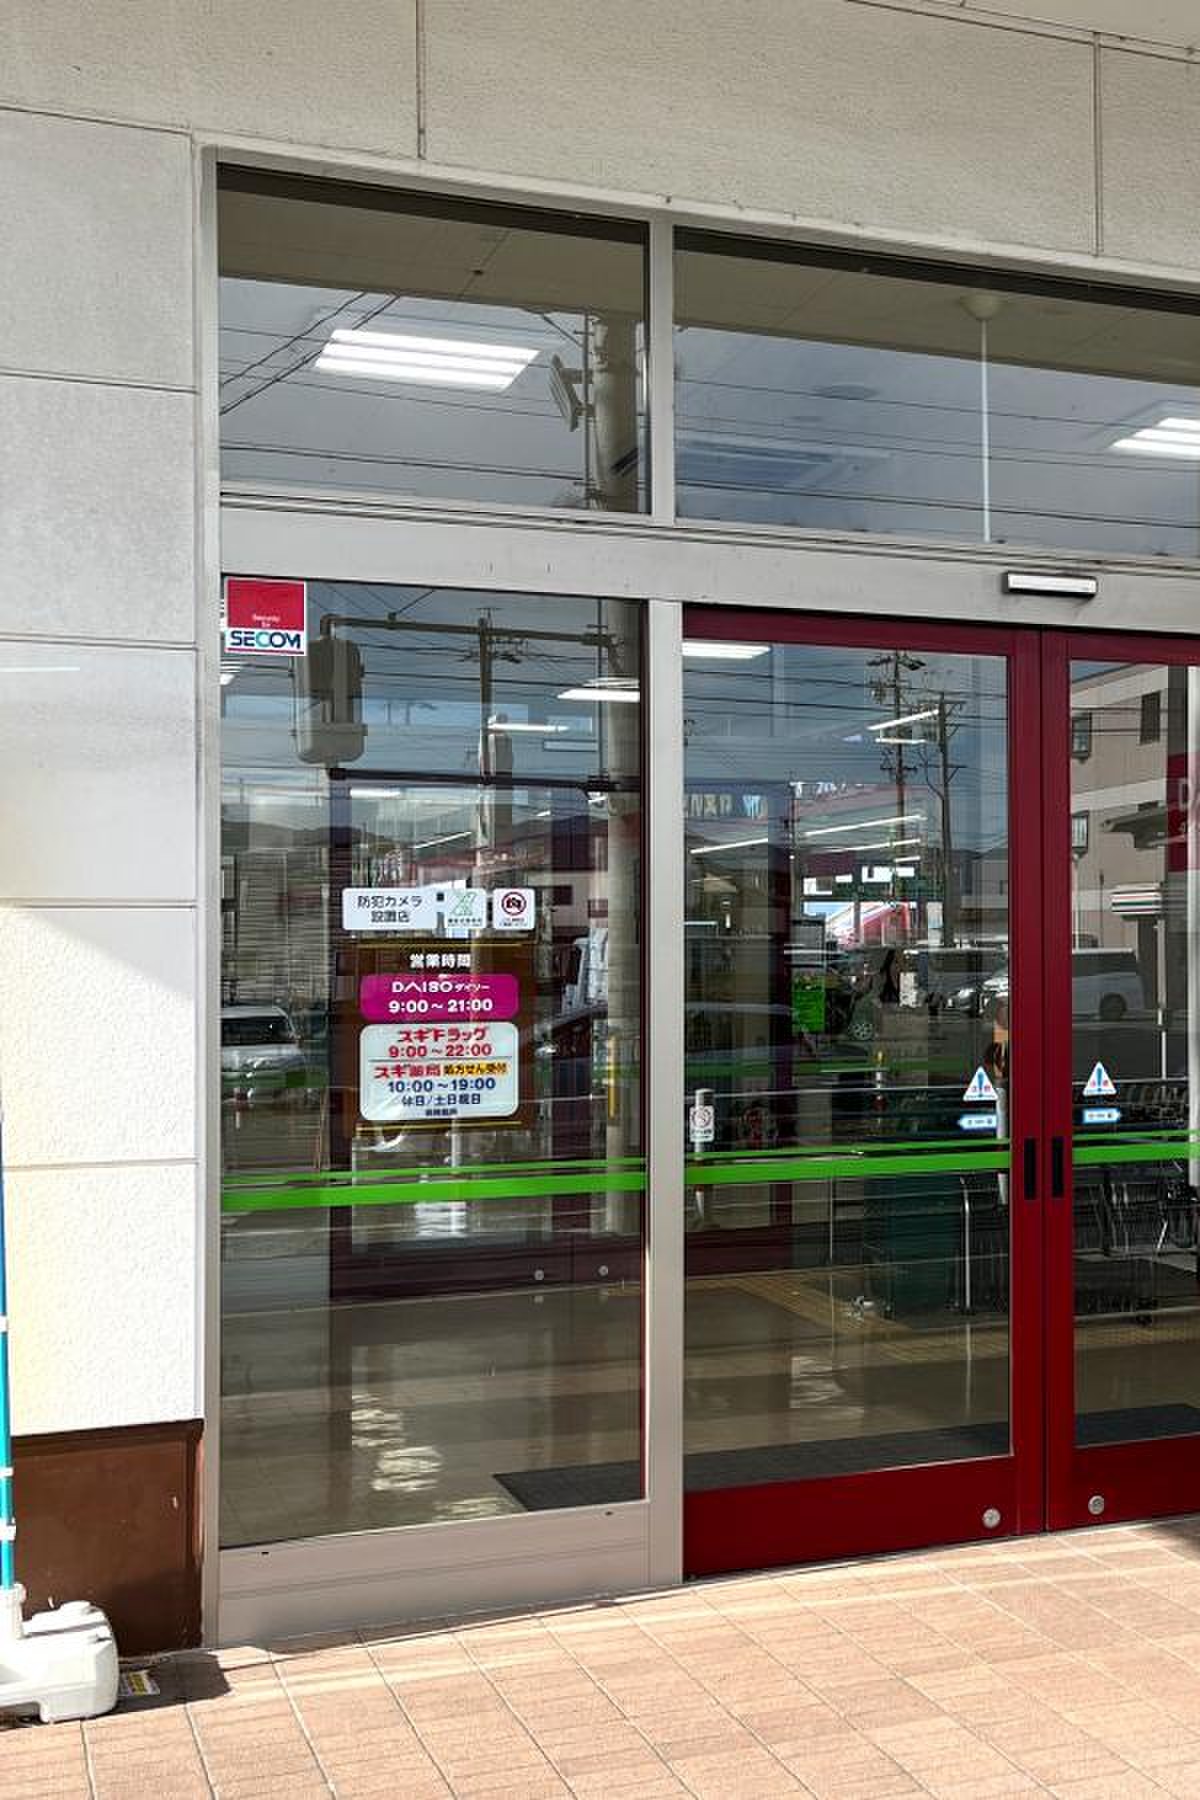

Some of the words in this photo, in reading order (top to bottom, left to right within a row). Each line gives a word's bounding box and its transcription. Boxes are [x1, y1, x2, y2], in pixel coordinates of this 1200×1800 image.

[229, 630, 301, 649] SECOM
[357, 895, 423, 909] 防犯カメラ
[410, 953, 472, 968] 営業時間
[391, 981, 452, 993] DAISO
[397, 1027, 489, 1042] スギドラッグ
